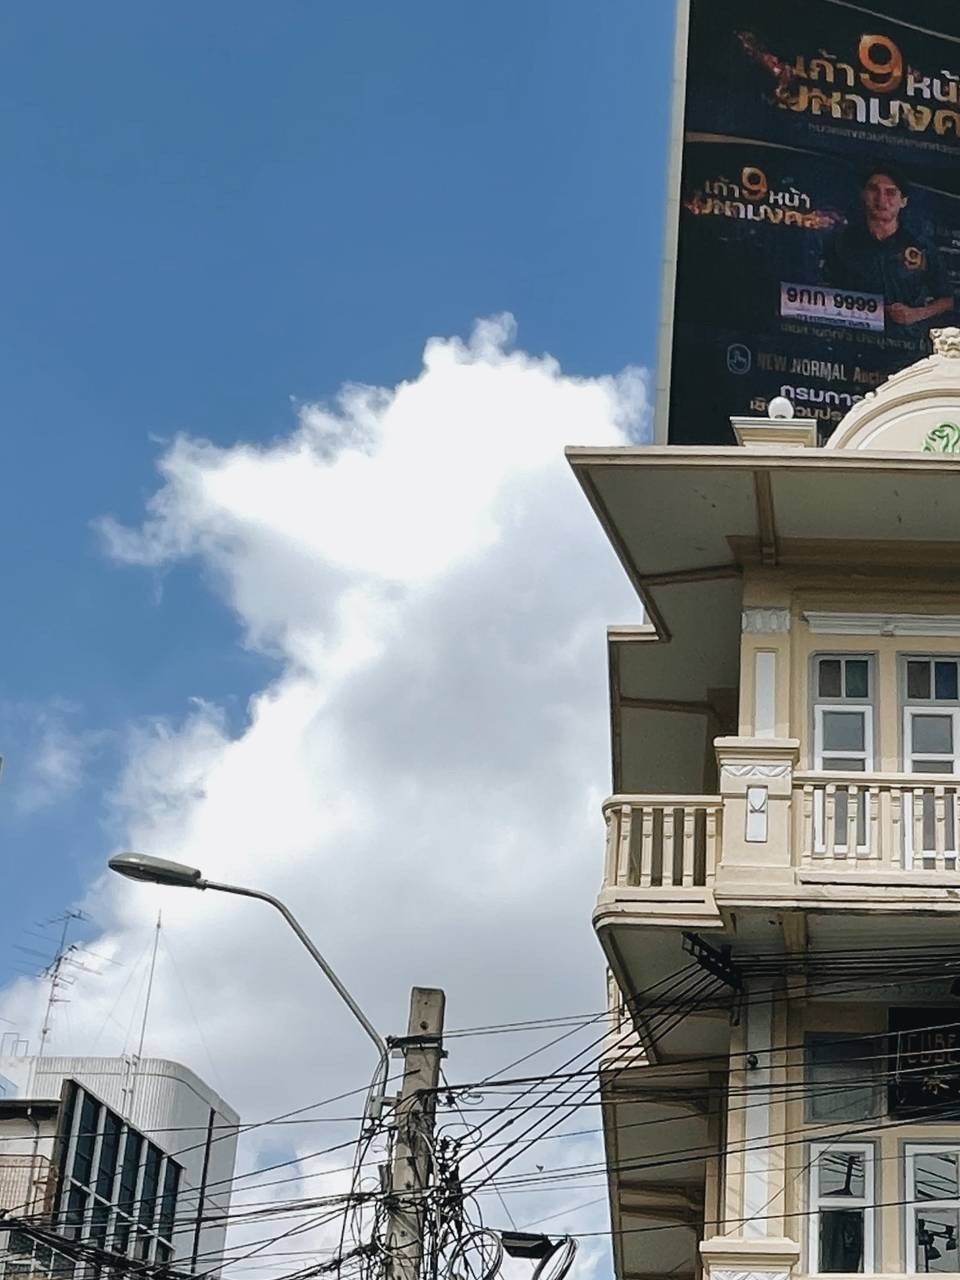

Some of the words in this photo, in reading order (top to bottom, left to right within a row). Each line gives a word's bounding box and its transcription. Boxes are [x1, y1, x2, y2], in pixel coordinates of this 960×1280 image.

[858, 33, 903, 93] 9
[741, 166, 769, 199] 9
[790, 359, 848, 382] NORMAL
